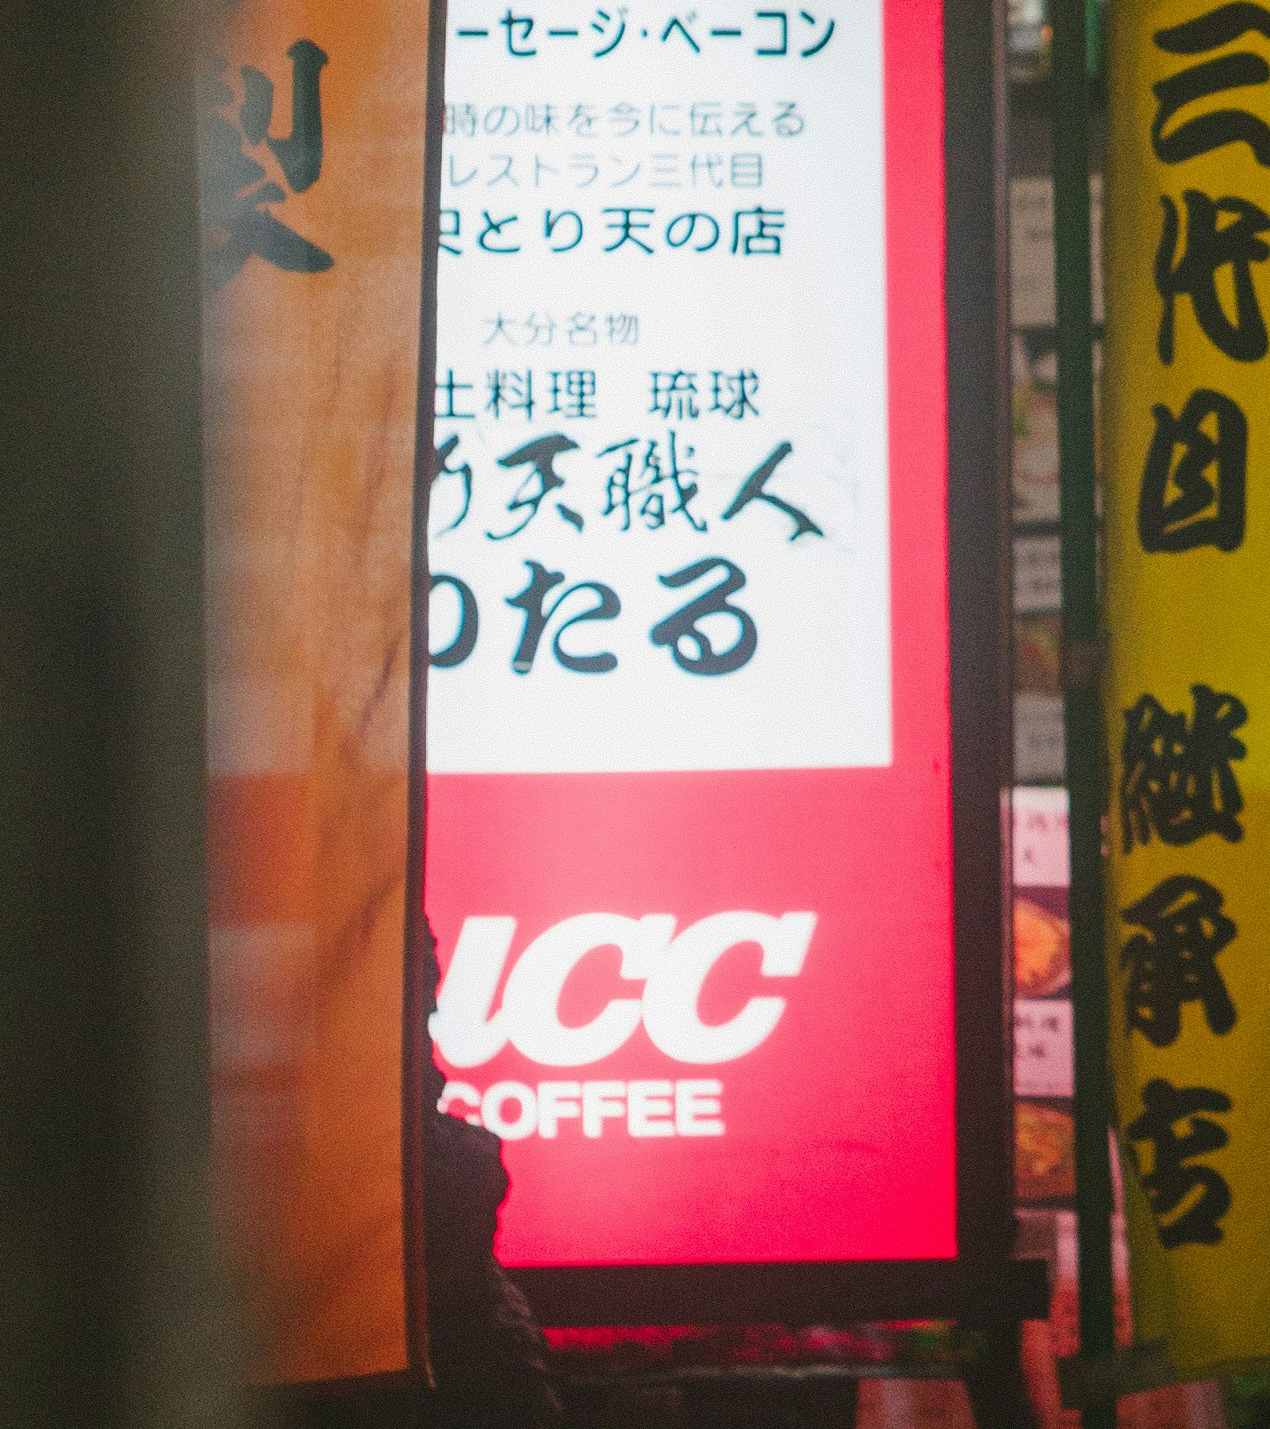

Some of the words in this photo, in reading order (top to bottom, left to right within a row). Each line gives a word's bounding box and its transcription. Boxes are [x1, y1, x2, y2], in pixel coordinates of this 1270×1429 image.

[457, 7, 837, 58] ーセージ・ベーコン
[449, 154, 764, 188] レストラン三代目
[482, 312, 640, 347] 大分名物
[648, 369, 760, 420] 琉球
